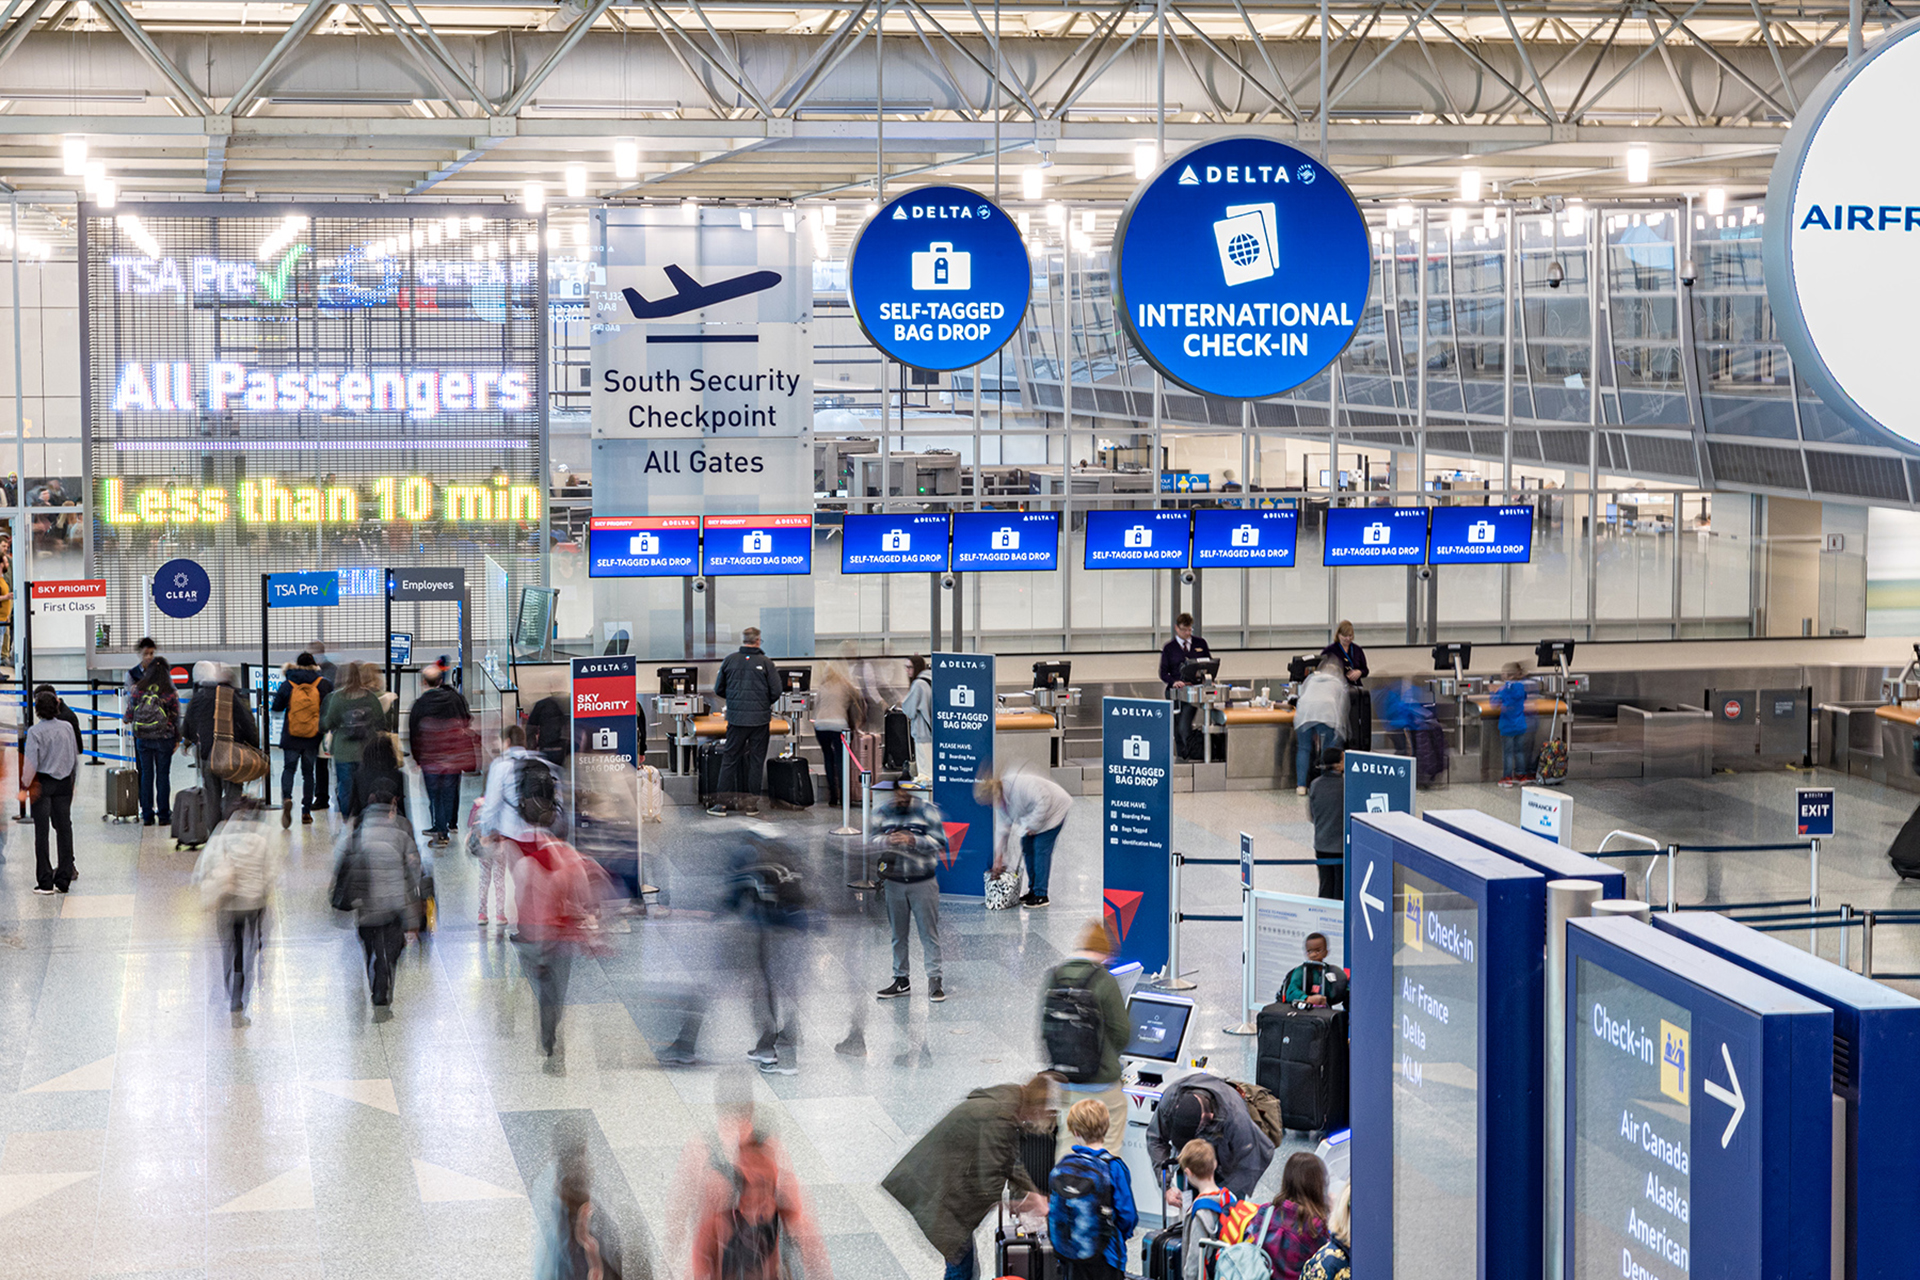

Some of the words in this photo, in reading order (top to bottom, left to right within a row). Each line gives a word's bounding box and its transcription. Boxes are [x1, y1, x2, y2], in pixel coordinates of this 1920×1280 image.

[1206, 165, 1290, 184] DELTA
[911, 205, 972, 220] DELTA
[109, 255, 185, 293] TSA
[193, 256, 258, 294] Pre
[879, 301, 1005, 321] SELF-TAGGED
[1137, 302, 1354, 329] INTERNATIONAL
[893, 323, 934, 342] BAG
[938, 323, 991, 342] DROP
[1182, 333, 1309, 358] CHECK-IN
[603, 368, 681, 393] South
[689, 368, 800, 397] Security
[113, 361, 194, 411] All
[206, 361, 532, 419] Passengers
[628, 404, 777, 433] Checkpoint
[643, 450, 681, 474] All
[689, 449, 764, 474] Gates
[104, 477, 230, 525] Less
[238, 477, 360, 523] than
[374, 475, 433, 521] 10
[443, 474, 543, 522] min
[1092, 551, 1142, 560] SELF-TAGGED
[1144, 550, 1160, 558] BAG
[1160, 550, 1182, 558] DROP
[1200, 550, 1250, 558] SELF-TAGGED
[1250, 549, 1266, 558] BAG
[1267, 549, 1288, 558] DROP
[1332, 548, 1380, 556] SELF-TAGGED
[1382, 547, 1397, 556] BAG
[1398, 546, 1420, 555] DROP
[1436, 546, 1485, 554] SELF-TAGGED
[1486, 546, 1502, 554] BAG
[1502, 545, 1524, 554] DROP
[597, 558, 650, 567] SELF-TAGGED
[651, 558, 668, 566] BAG
[669, 558, 692, 566] DROP
[710, 557, 762, 566] SELF-TAGGED
[764, 556, 780, 565] BAG
[781, 556, 804, 564] DROP
[850, 555, 900, 564] SELF-TAGGED
[902, 554, 918, 563] BAG
[920, 554, 942, 562] DROP
[959, 553, 1010, 562] SELF-TAGGED
[1011, 552, 1028, 561] BAG
[1028, 552, 1050, 560] DROP
[38, 586, 56, 594] SKY
[58, 584, 101, 593] PRIORITY
[274, 584, 297, 597] TSA
[300, 582, 319, 595] Pre
[402, 580, 454, 592] Employees
[165, 590, 198, 599] CLEAR
[43, 602, 66, 612] First
[68, 602, 96, 612] Class
[590, 664, 620, 672] DELTA
[948, 660, 978, 669] DELTA
[577, 693, 599, 703] SKY
[577, 700, 628, 712] PRIORITY
[936, 711, 988, 722] SELF-TAGGED
[1122, 708, 1154, 718] DELTA
[943, 720, 960, 730] BAG
[960, 722, 982, 730] DROP
[578, 754, 632, 765] SELF-TAGGED
[604, 763, 626, 772] DROP
[1108, 764, 1165, 778] SELF-TAGGED
[1362, 763, 1396, 776] DELTA
[1115, 775, 1134, 785] BAG
[1134, 776, 1158, 787] DROP
[1110, 800, 1130, 808] PLEASE
[1122, 812, 1140, 821] Boarding
[1802, 804, 1830, 817] EXIT
[1122, 826, 1132, 834] Bags
[1132, 826, 1148, 834] Tagged
[1122, 838, 1149, 848] Identification
[1149, 840, 1162, 850] Ready
[1427, 911, 1474, 963] Check-in
[1402, 976, 1416, 1002] Air
[1418, 984, 1449, 1025] France
[1402, 1014, 1426, 1050] Delta
[1593, 1003, 1654, 1066] Check-in
[1402, 1053, 1422, 1088] KLM
[1620, 1110, 1640, 1145] Air
[1642, 1121, 1689, 1176] Canada
[1646, 1170, 1689, 1224] Alaska
[1628, 1206, 1689, 1273] American
